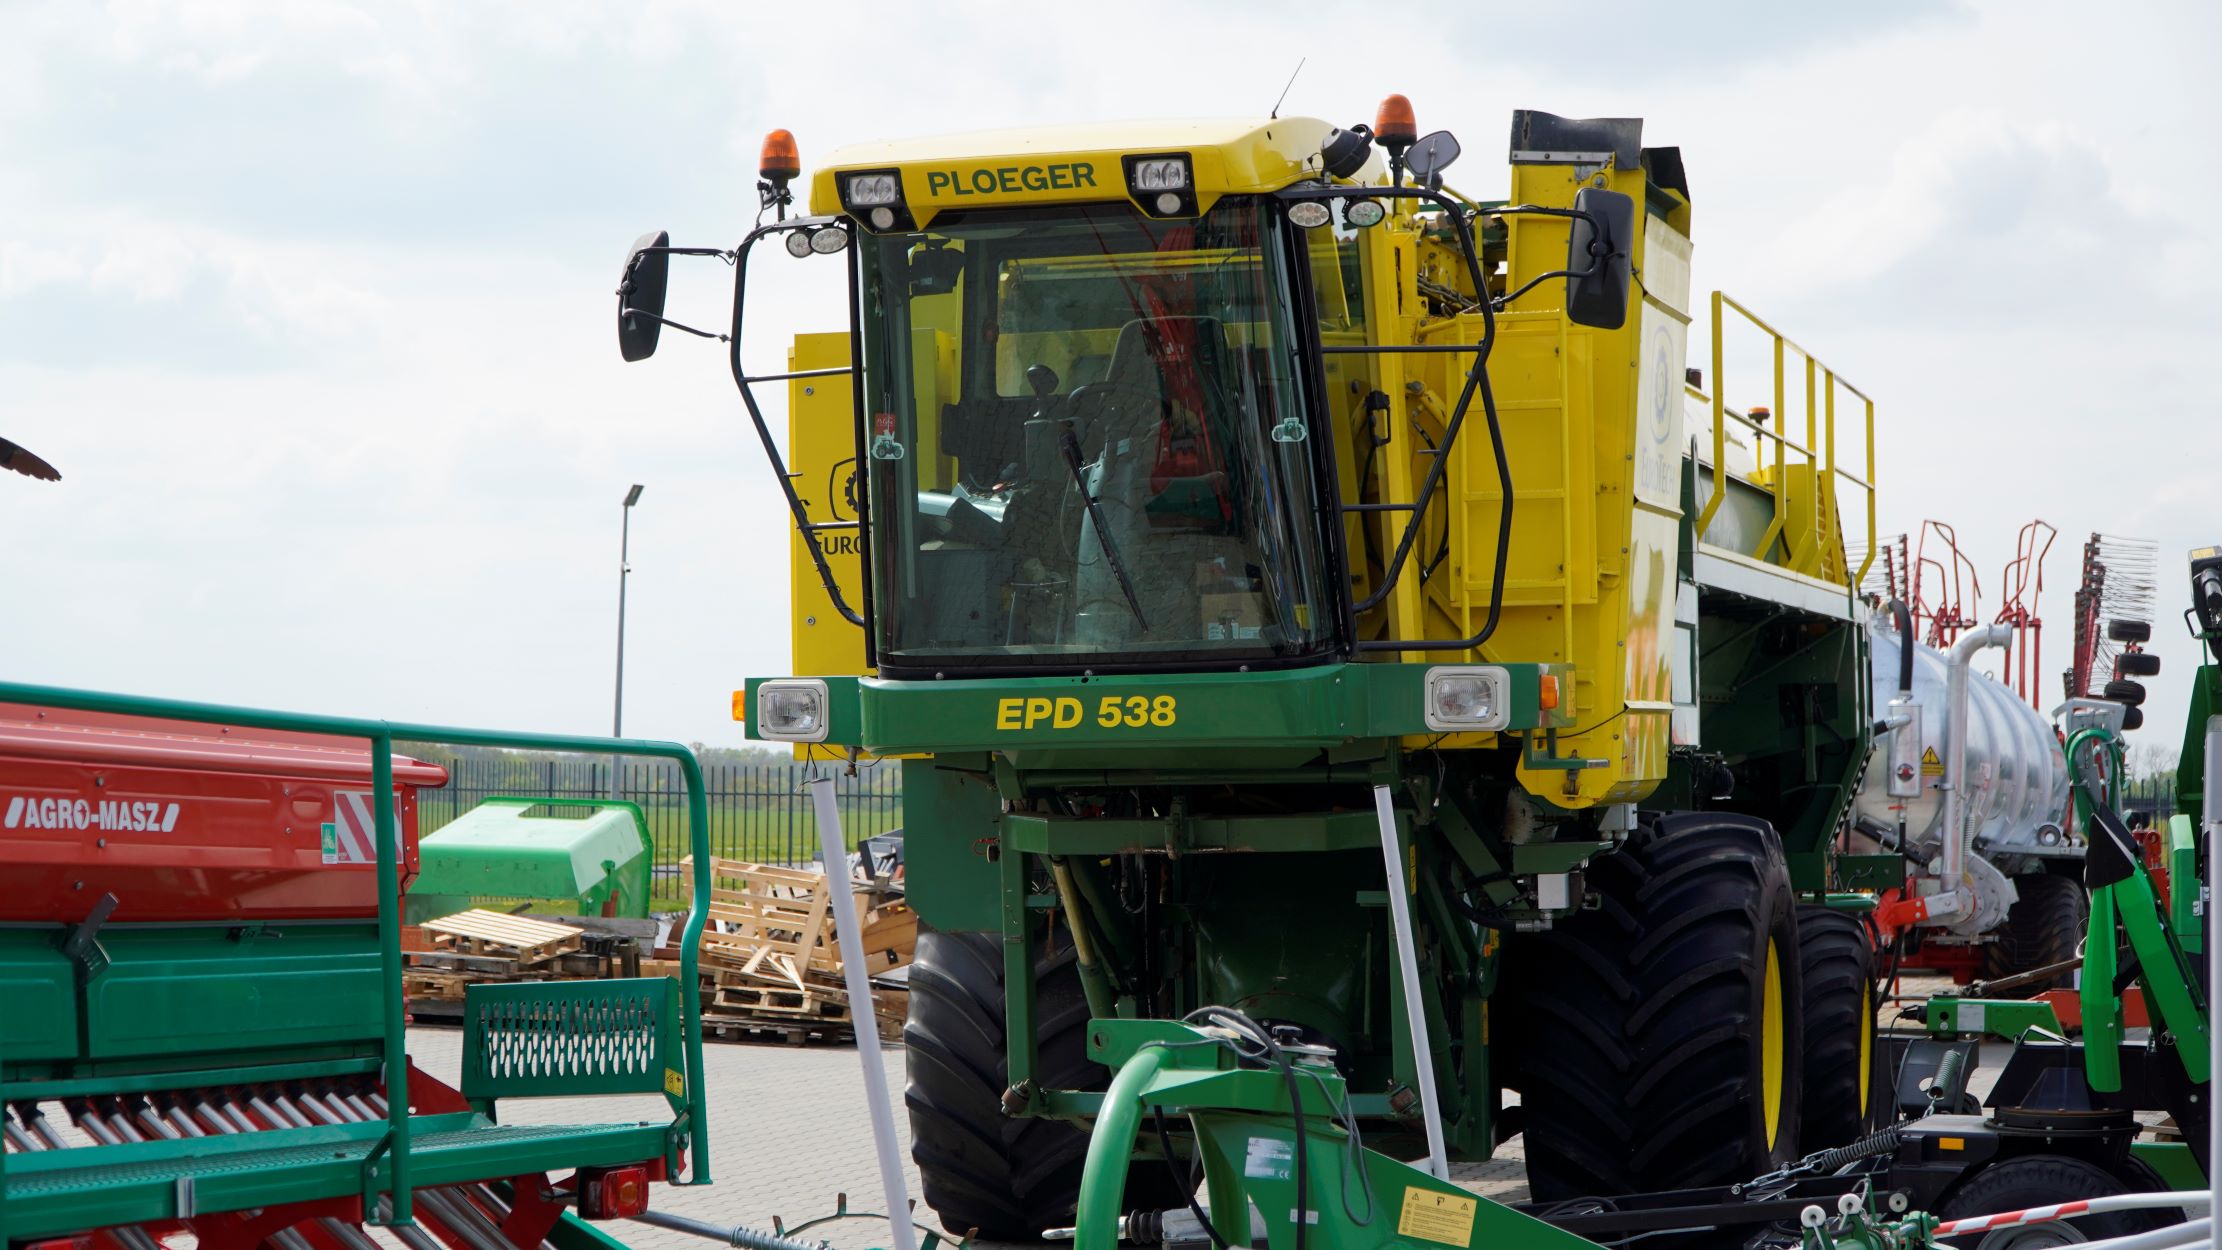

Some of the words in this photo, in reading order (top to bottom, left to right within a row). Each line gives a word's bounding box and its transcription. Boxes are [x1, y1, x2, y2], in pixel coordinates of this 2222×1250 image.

[927, 162, 1098, 197] PLOEGER
[996, 697, 1084, 730] EPD
[1097, 695, 1176, 728] 538
[24, 798, 161, 832] AGRO-MASZ
